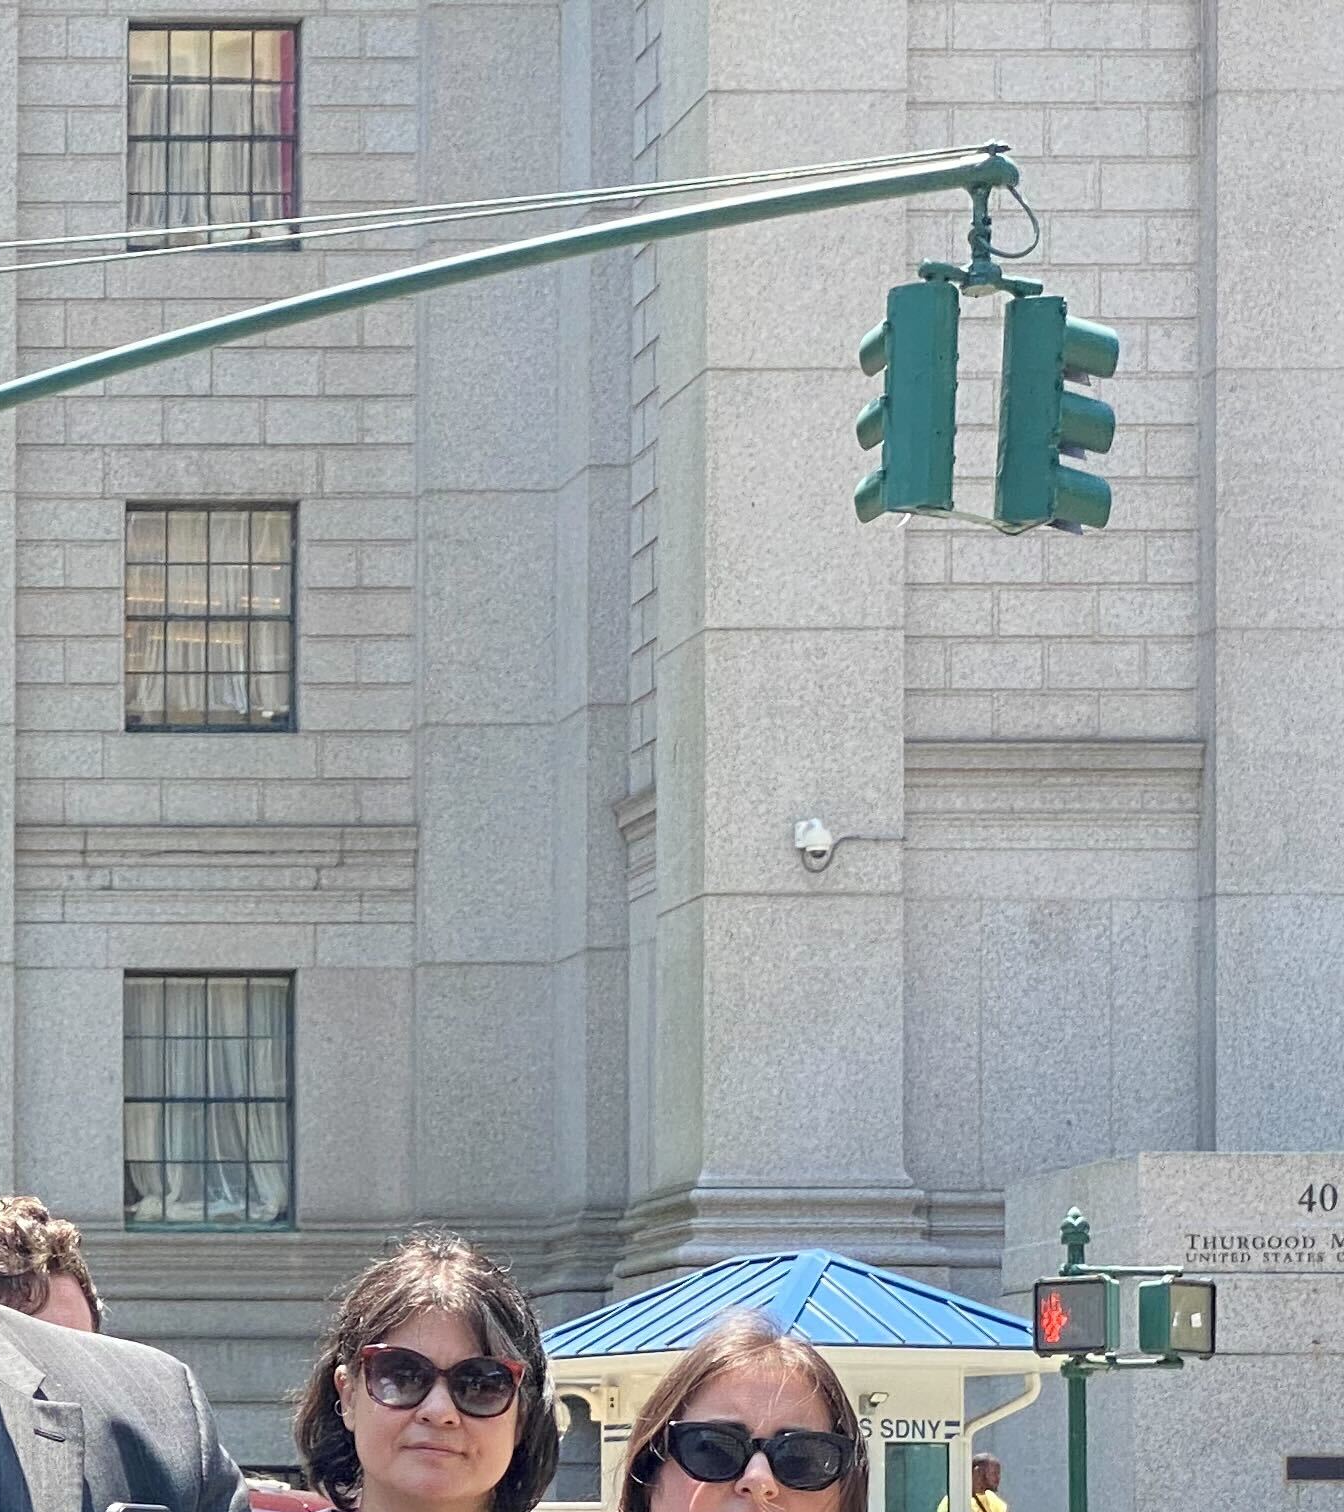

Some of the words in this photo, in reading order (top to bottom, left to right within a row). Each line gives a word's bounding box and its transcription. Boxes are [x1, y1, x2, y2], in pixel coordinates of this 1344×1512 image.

[1298, 1183, 1339, 1213] 40
[1184, 1233, 1317, 1251] THURGOOD
[1185, 1252, 1252, 1264] UNITED
[1262, 1252, 1326, 1264] STATES
[880, 1418, 942, 1439] SDNY
